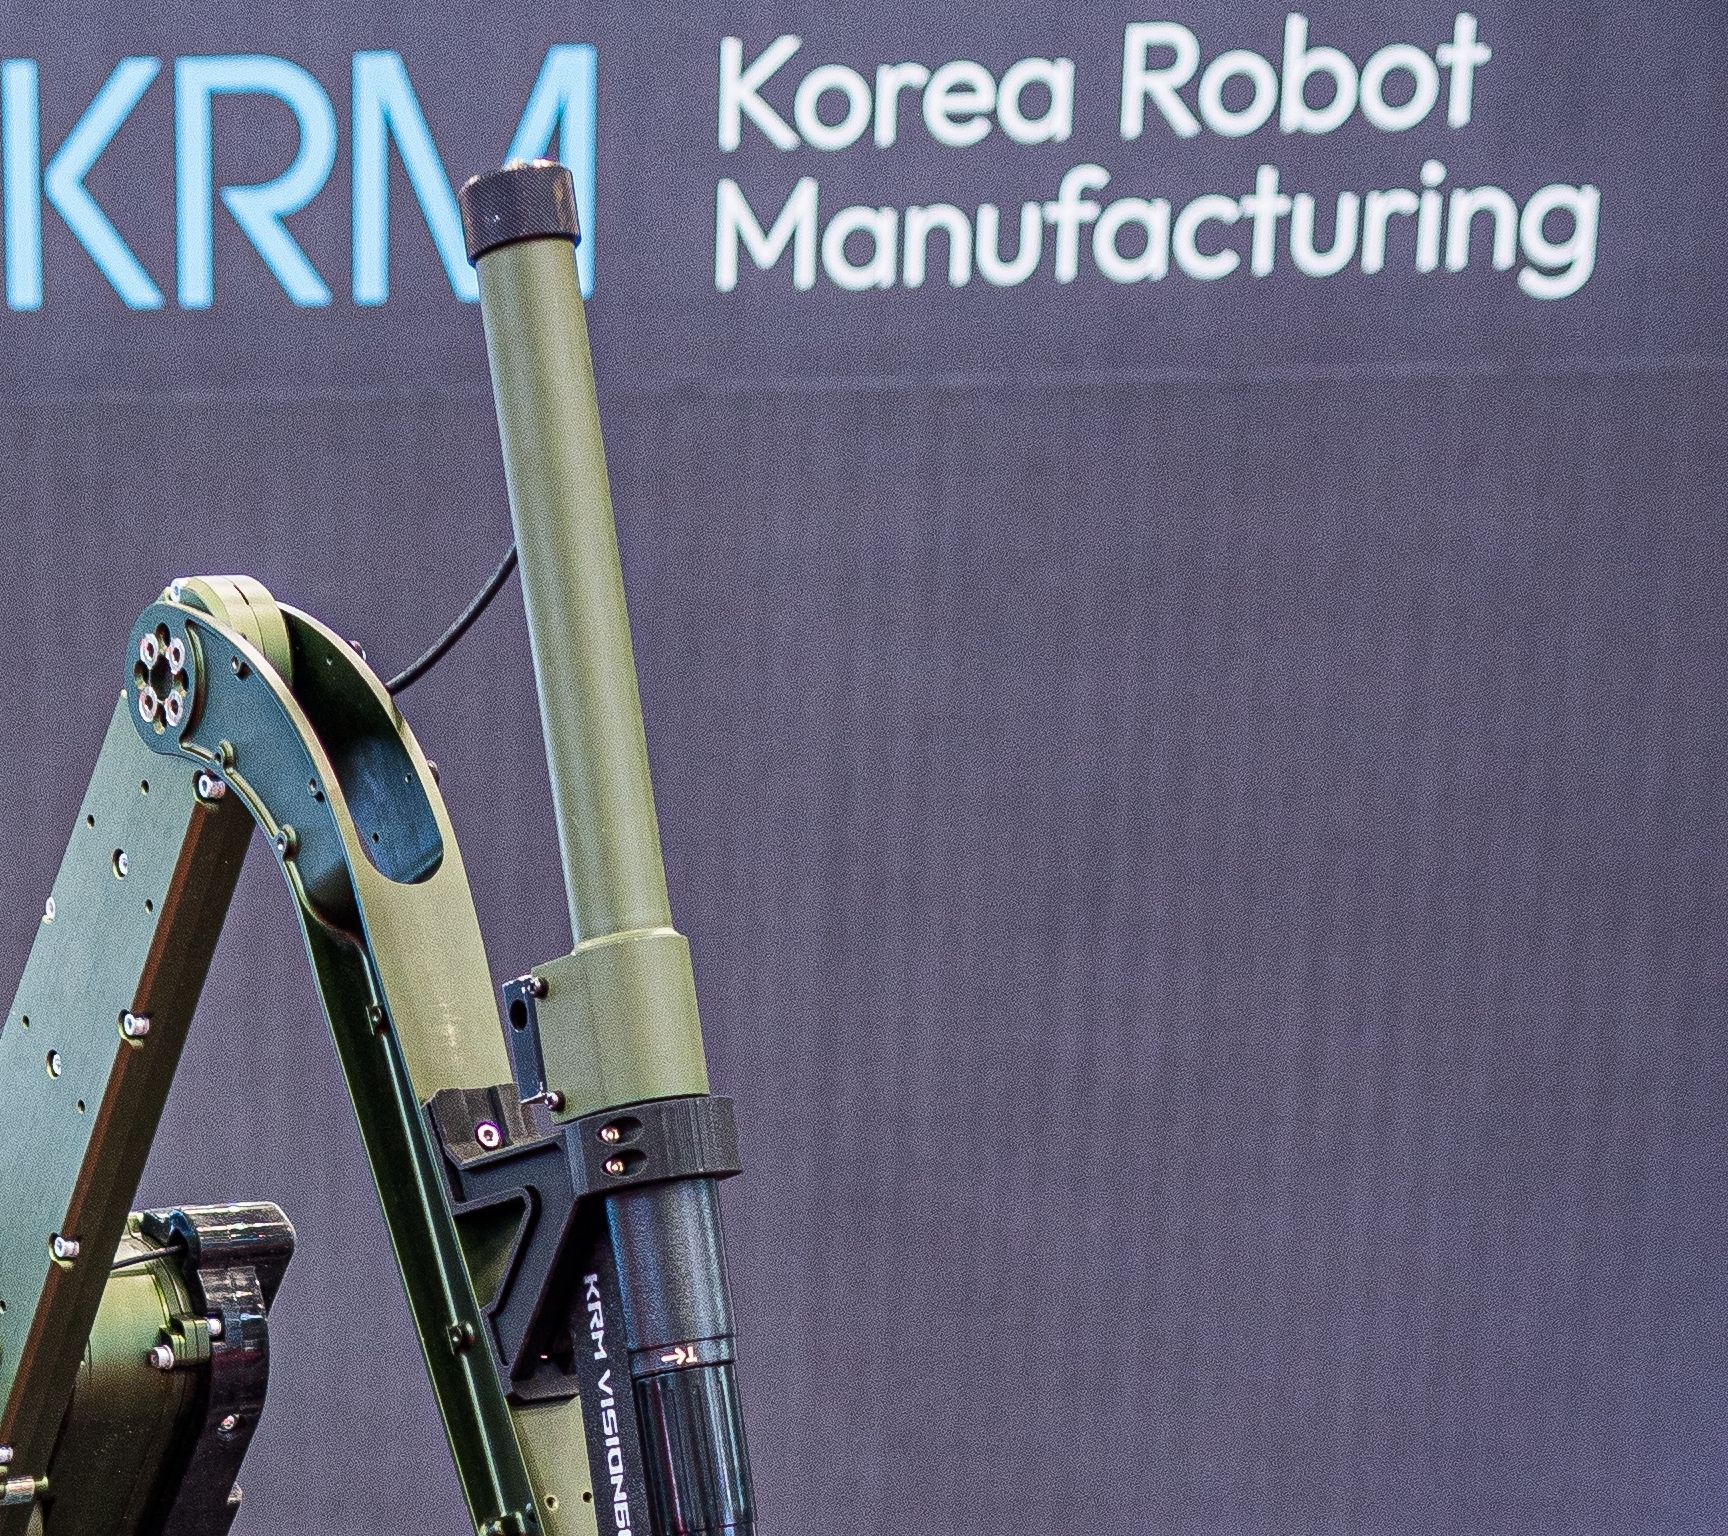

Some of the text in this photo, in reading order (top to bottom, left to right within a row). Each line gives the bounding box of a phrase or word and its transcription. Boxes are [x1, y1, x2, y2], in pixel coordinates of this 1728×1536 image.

[717, 12, 1491, 152] Korea Robot
[1, 44, 598, 312] KRM
[715, 159, 1601, 301] Manufacturing
[583, 1273, 608, 1361] KRM
